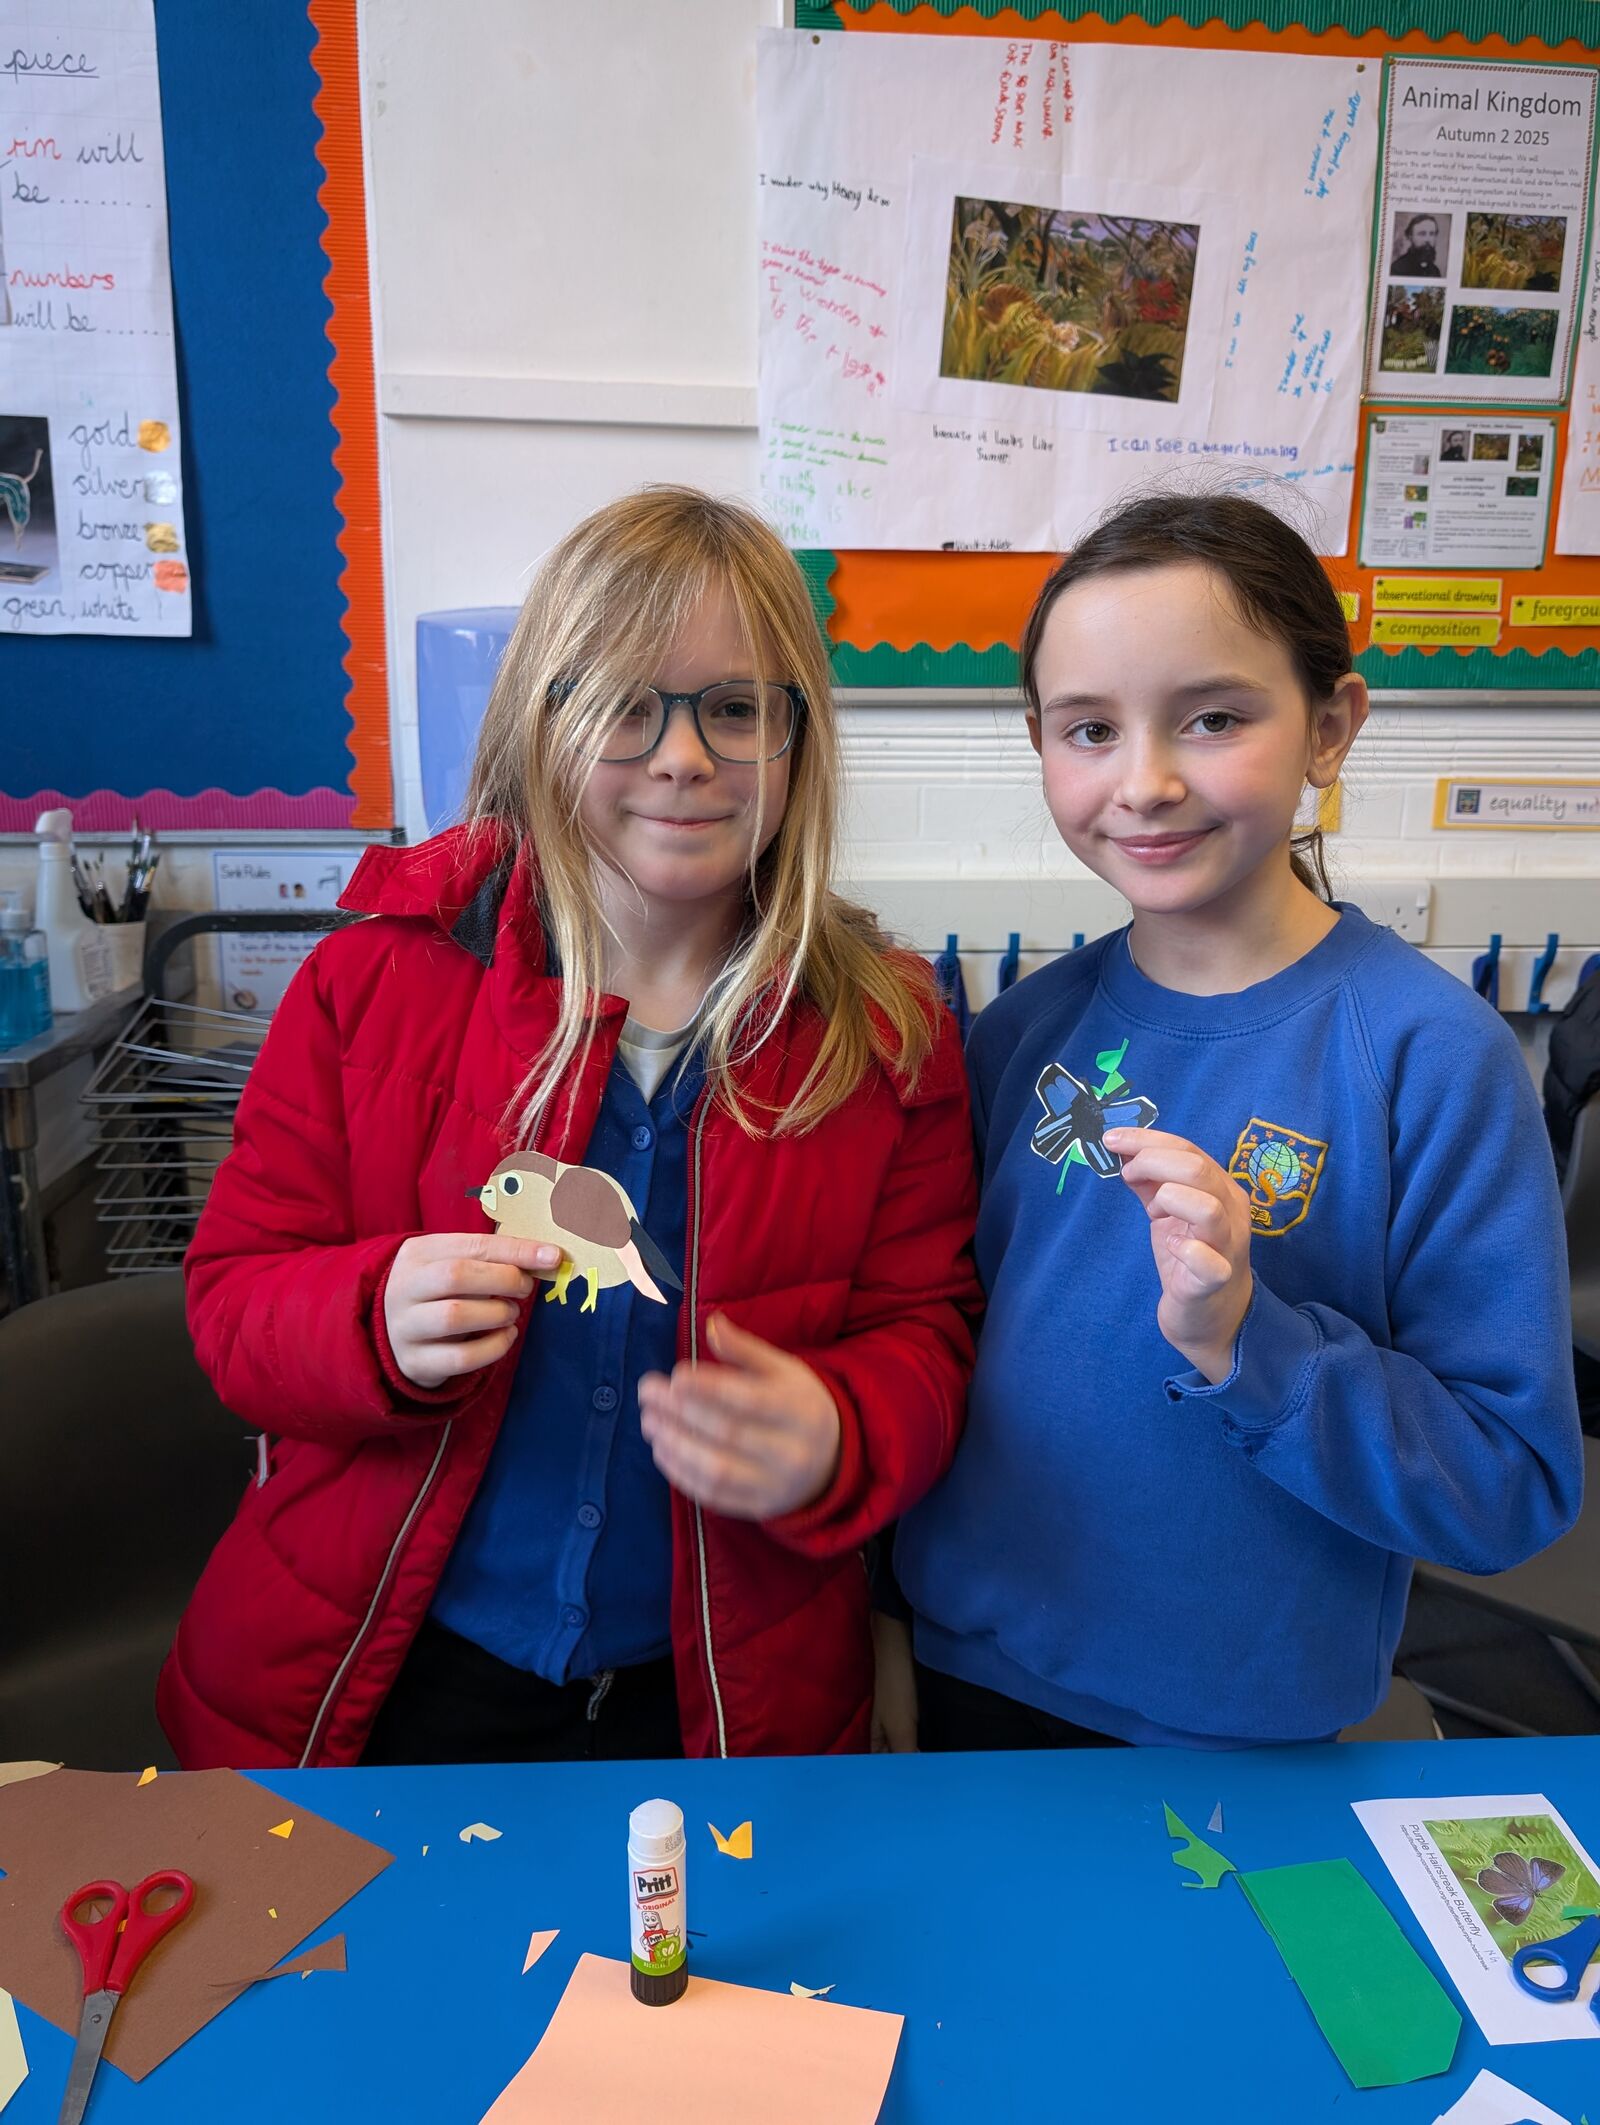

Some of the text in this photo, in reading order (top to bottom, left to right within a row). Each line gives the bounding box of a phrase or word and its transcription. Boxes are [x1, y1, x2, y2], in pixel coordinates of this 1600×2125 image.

[4, 48, 97, 84] piece
[1402, 86, 1581, 119] Animal Kingdom
[76, 130, 144, 164] will
[1436, 126, 1550, 146] Autumn 2 2025
[9, 263, 115, 290] numbers
[14, 300, 56, 331] will
[68, 410, 137, 472] gold
[1108, 438, 1119, 453] I
[1121, 438, 1150, 453] can
[73, 467, 147, 499] silver
[77, 509, 146, 542] bronze
[80, 562, 154, 592] copper
[81, 594, 141, 623] white
[1376, 589, 1498, 606] observational drawing
[1390, 621, 1481, 638] composition
[1489, 795, 1567, 820] equality
[637, 1873, 673, 1893] Pritt
[1409, 1824, 1482, 1938] Purple Hairstreak Butterfly
[642, 1898, 676, 1911] ORIGINAL
[649, 1934, 663, 1944] Pritt
